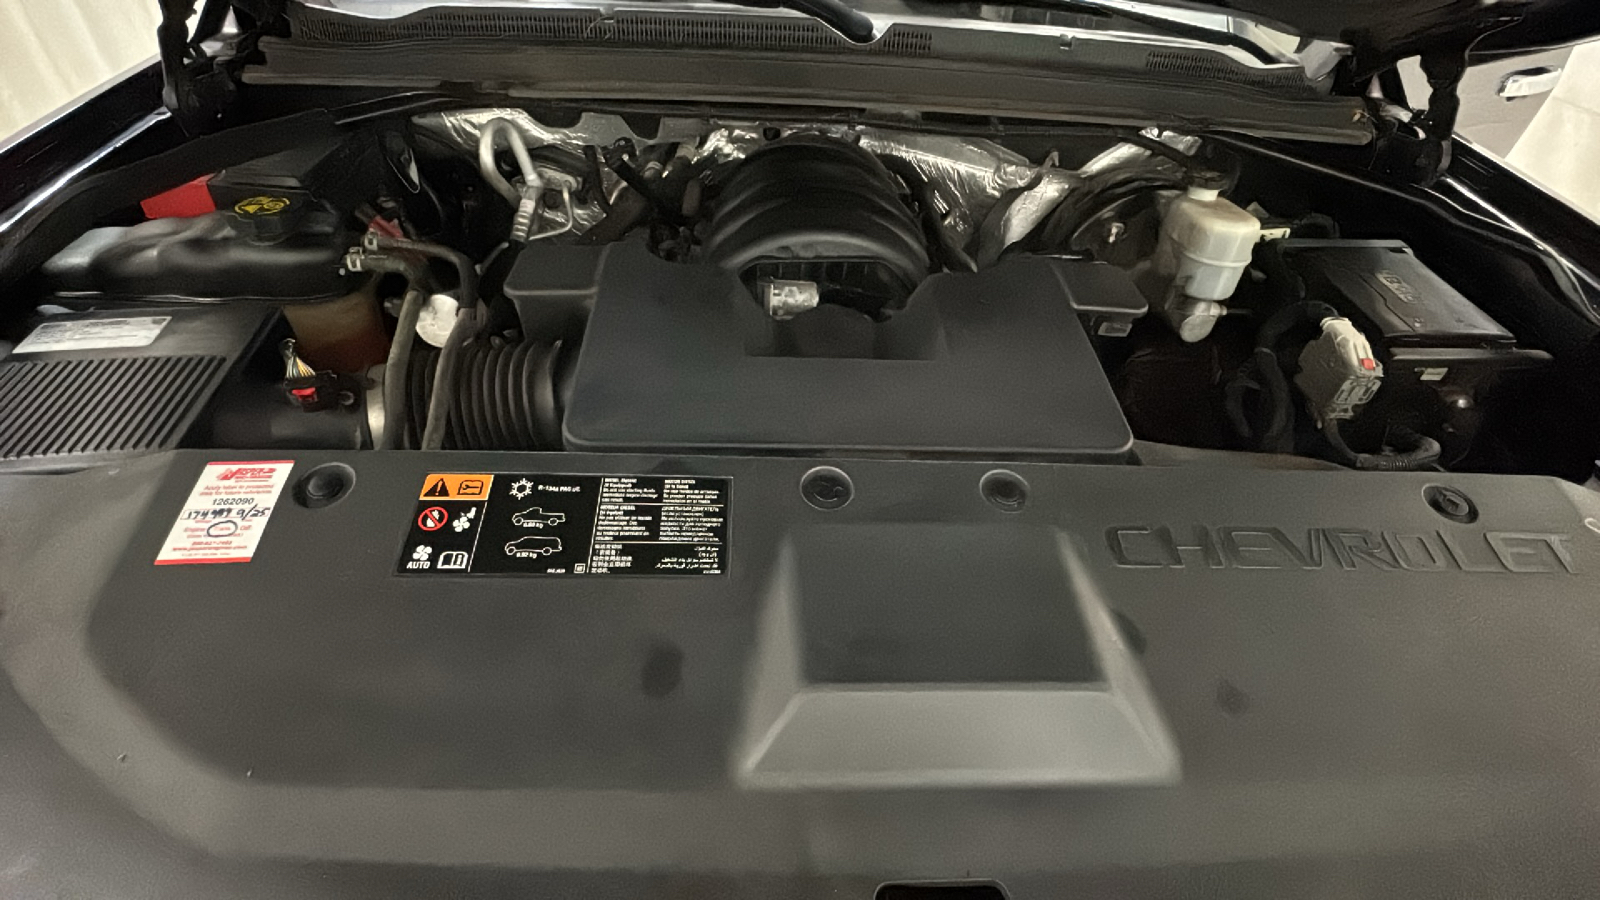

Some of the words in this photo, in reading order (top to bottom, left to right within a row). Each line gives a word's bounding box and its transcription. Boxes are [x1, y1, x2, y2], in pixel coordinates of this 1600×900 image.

[212, 498, 254, 506] 1262090
[1105, 525, 1579, 574] CHEVROLET
[406, 561, 430, 569] AUTO
